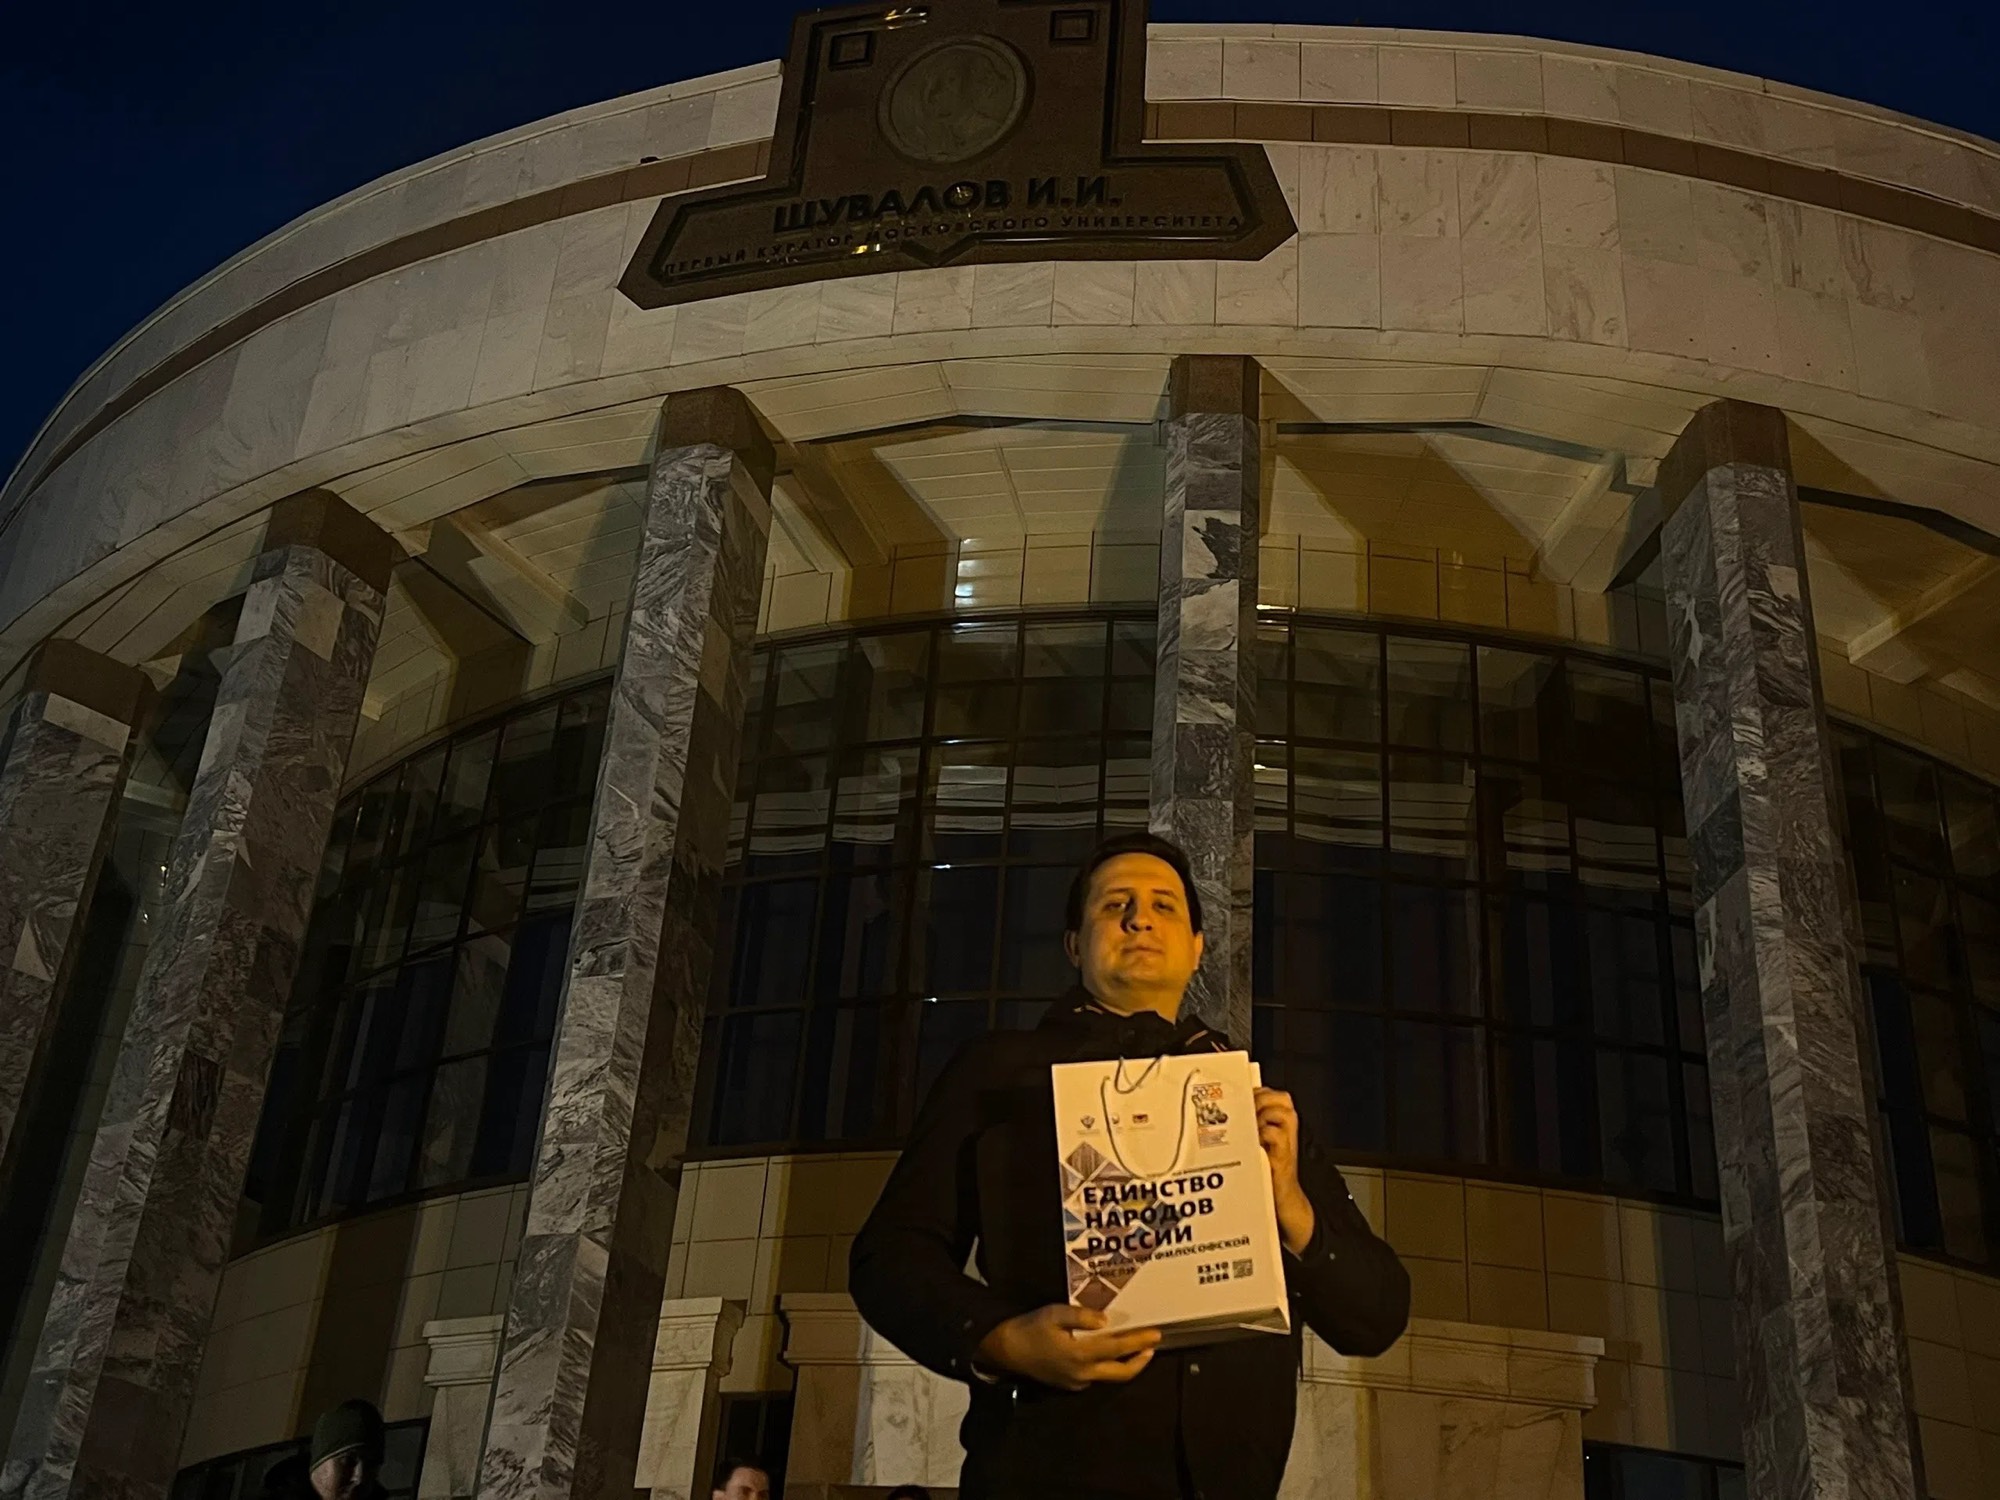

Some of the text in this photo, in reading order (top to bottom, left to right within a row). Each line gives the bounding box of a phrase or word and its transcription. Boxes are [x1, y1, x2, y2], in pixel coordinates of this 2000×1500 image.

[773, 175, 1122, 233] ШУВАЛОВ И.И.
[664, 215, 1241, 275] ПЕРВЫЙ КУРАТОР МОСКОВСКОГО УНИВЕРСИТЕТА
[1083, 1173, 1224, 1207] ЕДИНСТВО
[1085, 1198, 1214, 1229] НАРОДОВ
[1087, 1225, 1193, 1256] РОССИИ
